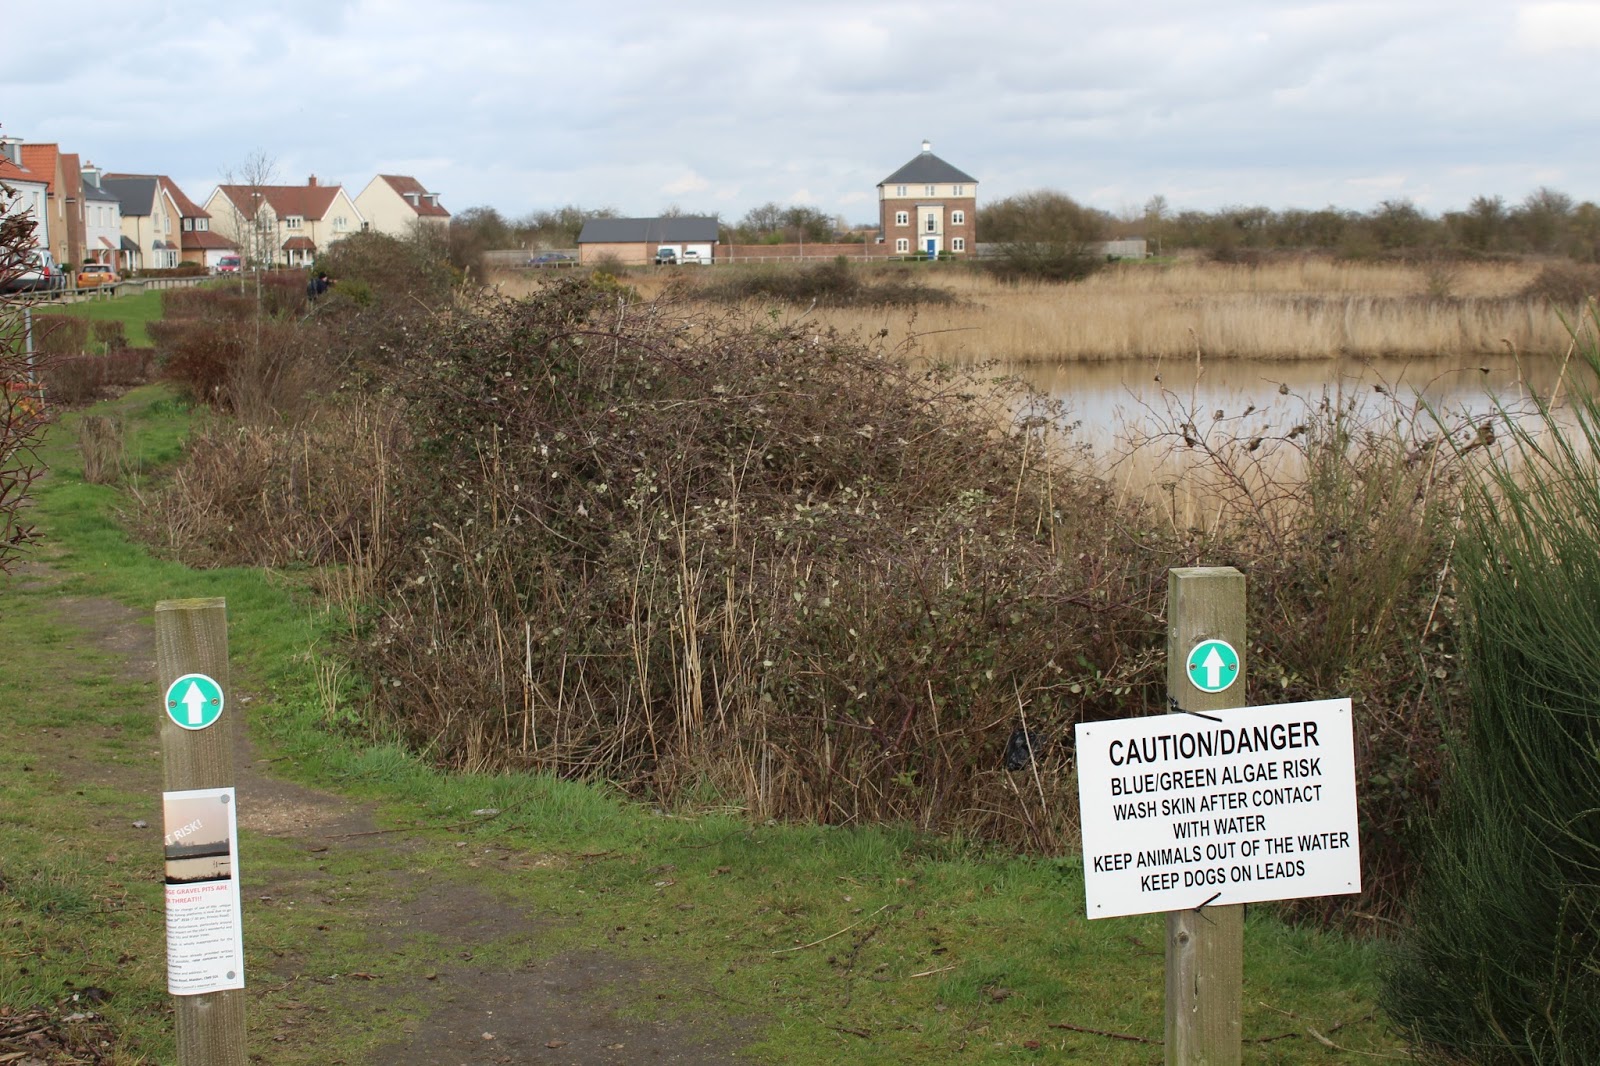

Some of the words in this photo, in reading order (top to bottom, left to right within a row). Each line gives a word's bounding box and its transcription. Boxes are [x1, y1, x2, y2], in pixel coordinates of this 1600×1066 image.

[1109, 721, 1319, 766] CAUTION/DANGER
[1111, 768, 1217, 796] BLUE/GREEN
[1222, 762, 1278, 785] ALGAE
[1283, 757, 1322, 779] RISK
[1113, 801, 1157, 821] WASH
[1162, 797, 1195, 816] SKIN
[1200, 792, 1248, 812] AFTER
[1252, 784, 1322, 807] CONTACT
[174, 819, 202, 840] RISK!
[1173, 820, 1210, 839] WITH
[1214, 815, 1266, 835] WATER
[1094, 853, 1132, 872] KEEP
[1137, 845, 1202, 868] ANIMALS
[1206, 842, 1236, 860] OUT
[1241, 839, 1260, 857] OF
[1264, 836, 1294, 855] THE
[1297, 832, 1350, 852] WATER
[1141, 872, 1179, 892] KEEP
[1184, 867, 1226, 887] DOGS
[1231, 865, 1251, 883] ON
[1256, 860, 1305, 880] LEADS
